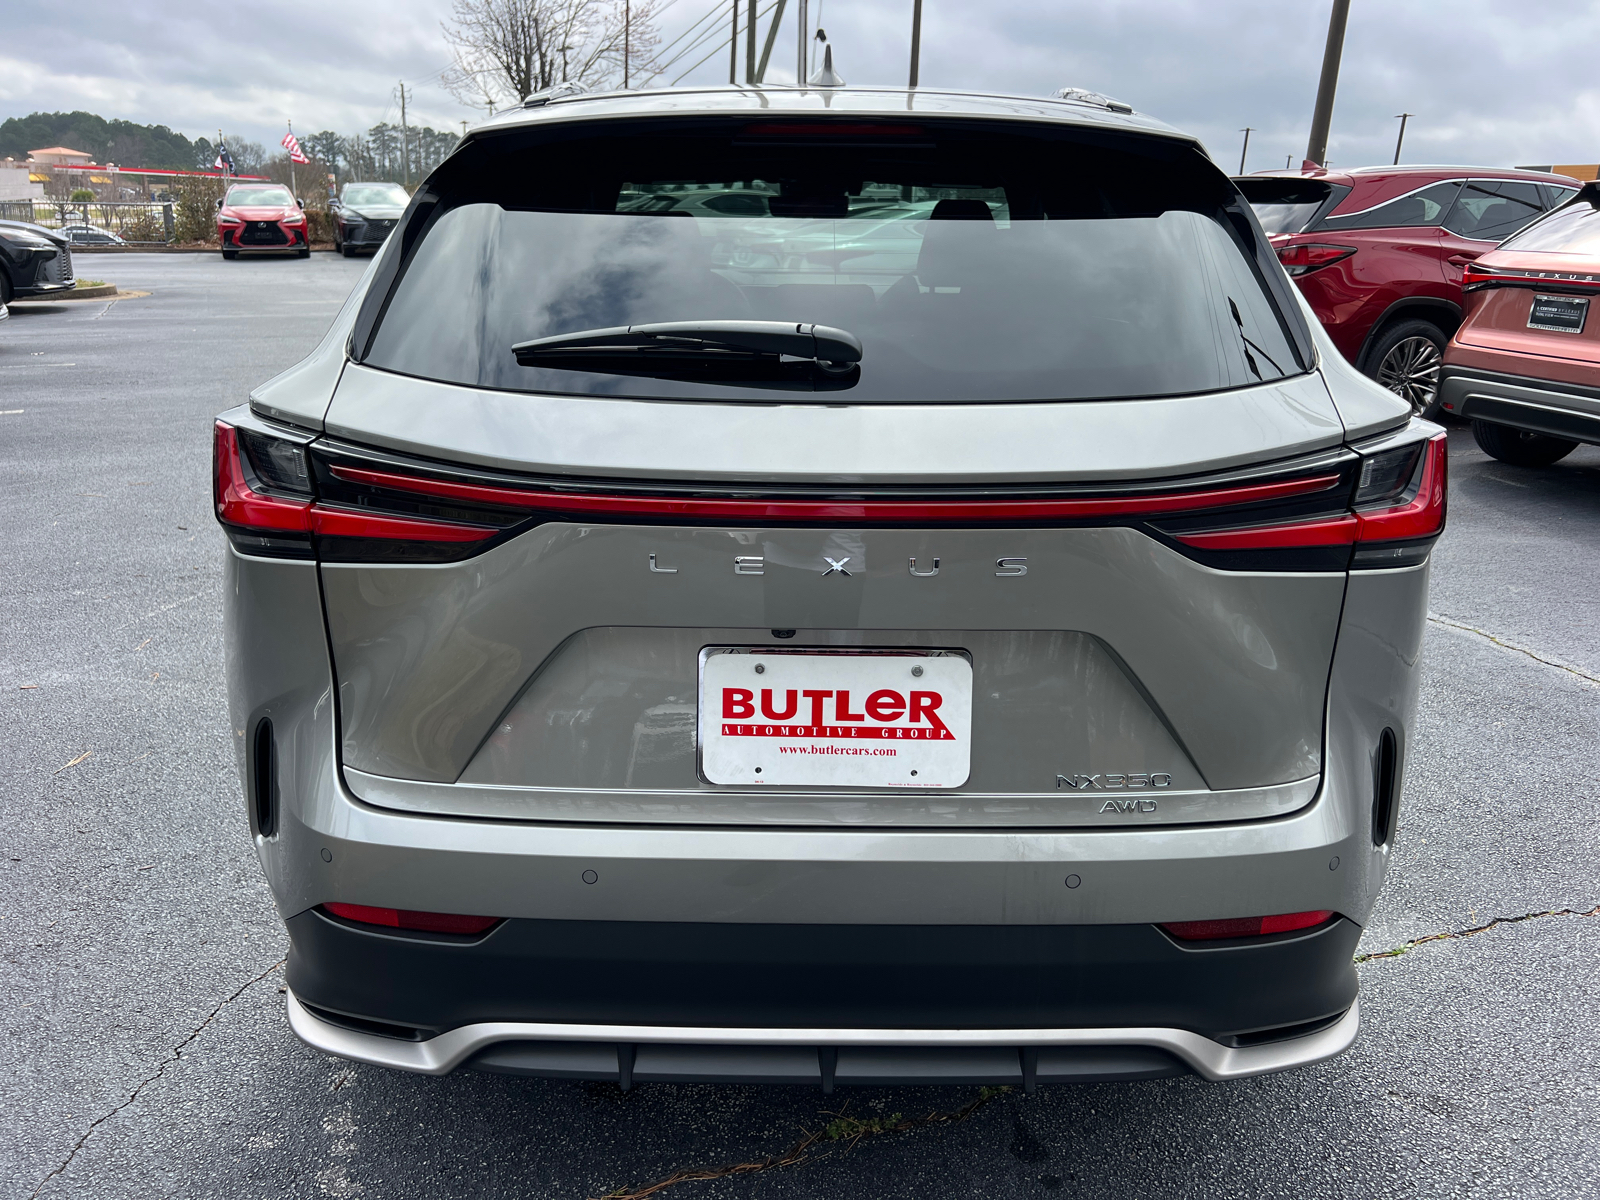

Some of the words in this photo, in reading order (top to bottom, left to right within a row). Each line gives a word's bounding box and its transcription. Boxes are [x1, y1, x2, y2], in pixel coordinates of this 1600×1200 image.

[1525, 272, 1593, 281] LEXUS
[649, 553, 1028, 577] LEXUS
[723, 725, 858, 737] AUTOMOTIVE
[881, 727, 947, 739] GROUP
[779, 745, 897, 757] www.butlercars.com
[1056, 773, 1172, 789] NX350
[1098, 799, 1157, 813] AWD
